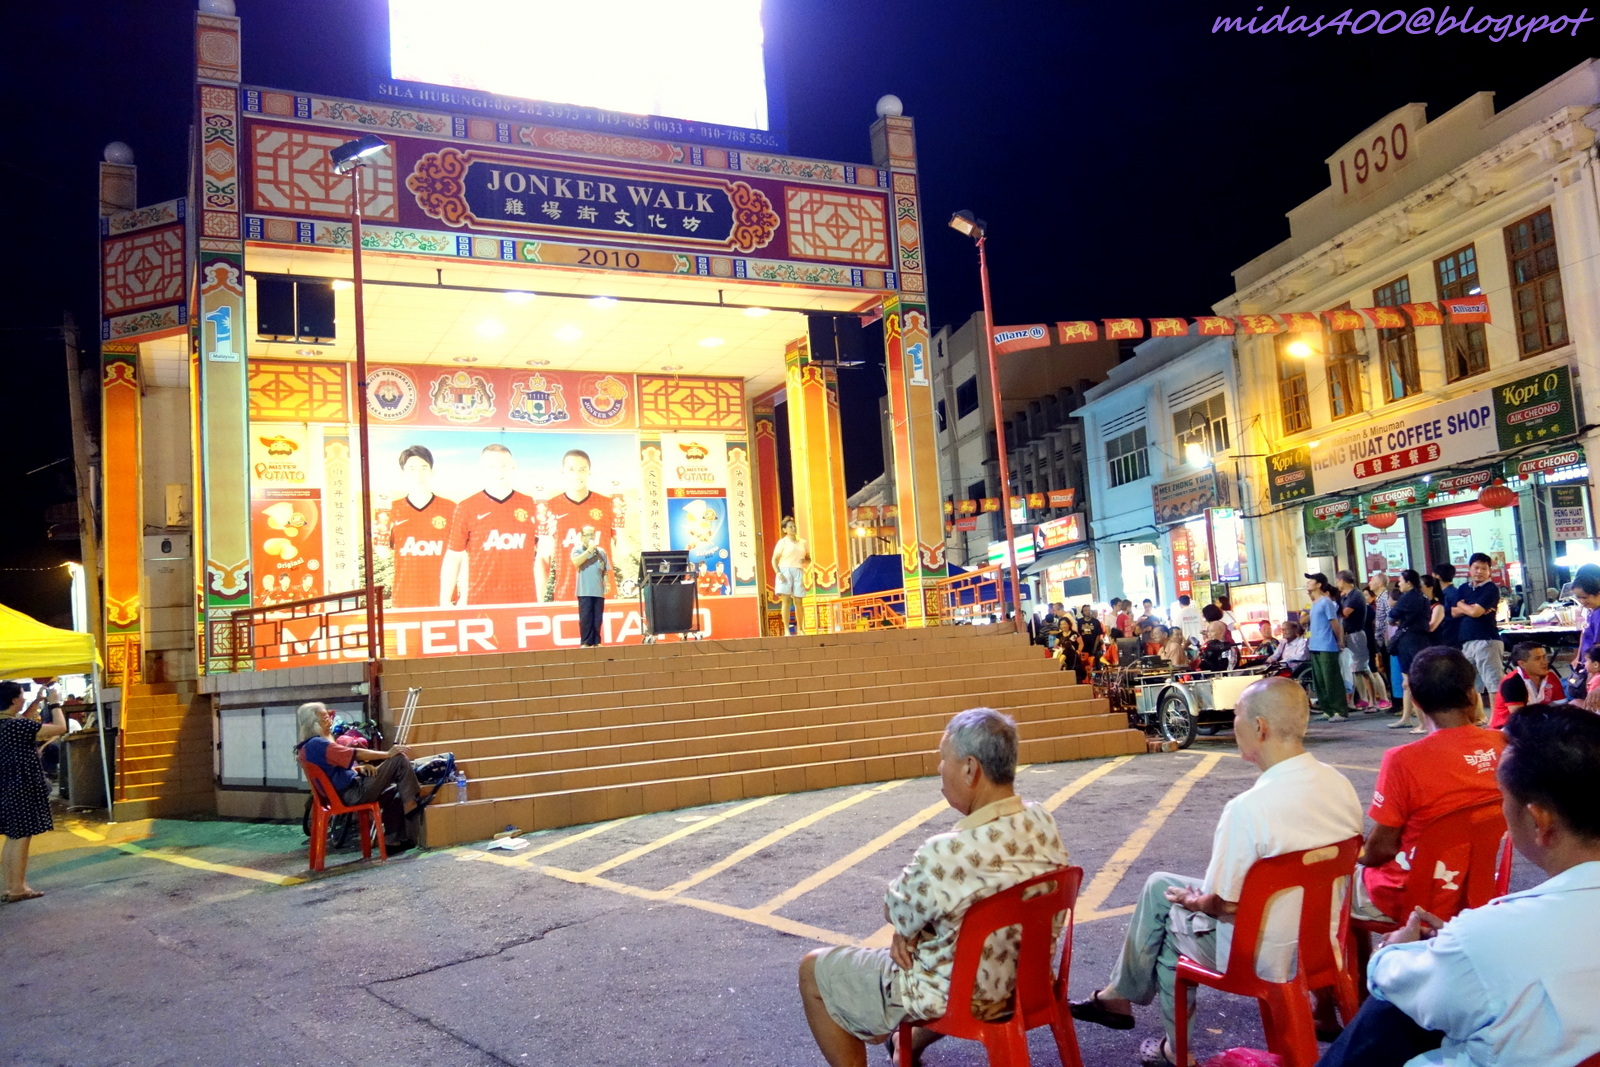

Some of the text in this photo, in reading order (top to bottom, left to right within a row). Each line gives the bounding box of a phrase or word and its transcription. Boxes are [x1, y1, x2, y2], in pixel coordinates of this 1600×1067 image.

[379, 84, 413, 98] SILA
[547, 104, 580, 121] 3973
[654, 121, 683, 134] 0033
[700, 126, 746, 143] 010-788
[1339, 122, 1408, 195] 1930
[487, 169, 715, 214] JONKER WALK
[503, 197, 702, 233] 雞場街文化坊
[576, 247, 641, 269] 2010
[1453, 305, 1480, 313] Allianz
[994, 330, 1028, 344] Allianz
[1502, 373, 1558, 406] Kopi O
[584, 401, 606, 419] JONKER
[607, 401, 622, 418] WALK
[1510, 403, 1557, 423] AIK CHEONG
[1349, 436, 1383, 462] HUAT
[1387, 419, 1443, 451] COFFEE
[1447, 405, 1490, 435] SHOP
[1362, 429, 1368, 439] &
[1370, 420, 1405, 436] Minuman
[1271, 452, 1293, 471] Kopi
[1521, 453, 1575, 472] AIK CHEONG
[255, 463, 305, 480] POTATO
[676, 466, 715, 481] POTATO
[1285, 473, 1304, 481] CHEONG
[1442, 472, 1487, 489] AIK CHEONG
[1159, 486, 1171, 495] MEI
[1373, 489, 1413, 503] AIK CHEONG
[1325, 502, 1348, 513] CHEONG
[1554, 509, 1582, 517] HENG HUAT
[1572, 517, 1583, 525] SHOP
[276, 557, 305, 569] Original
[279, 618, 497, 662] MISTER
